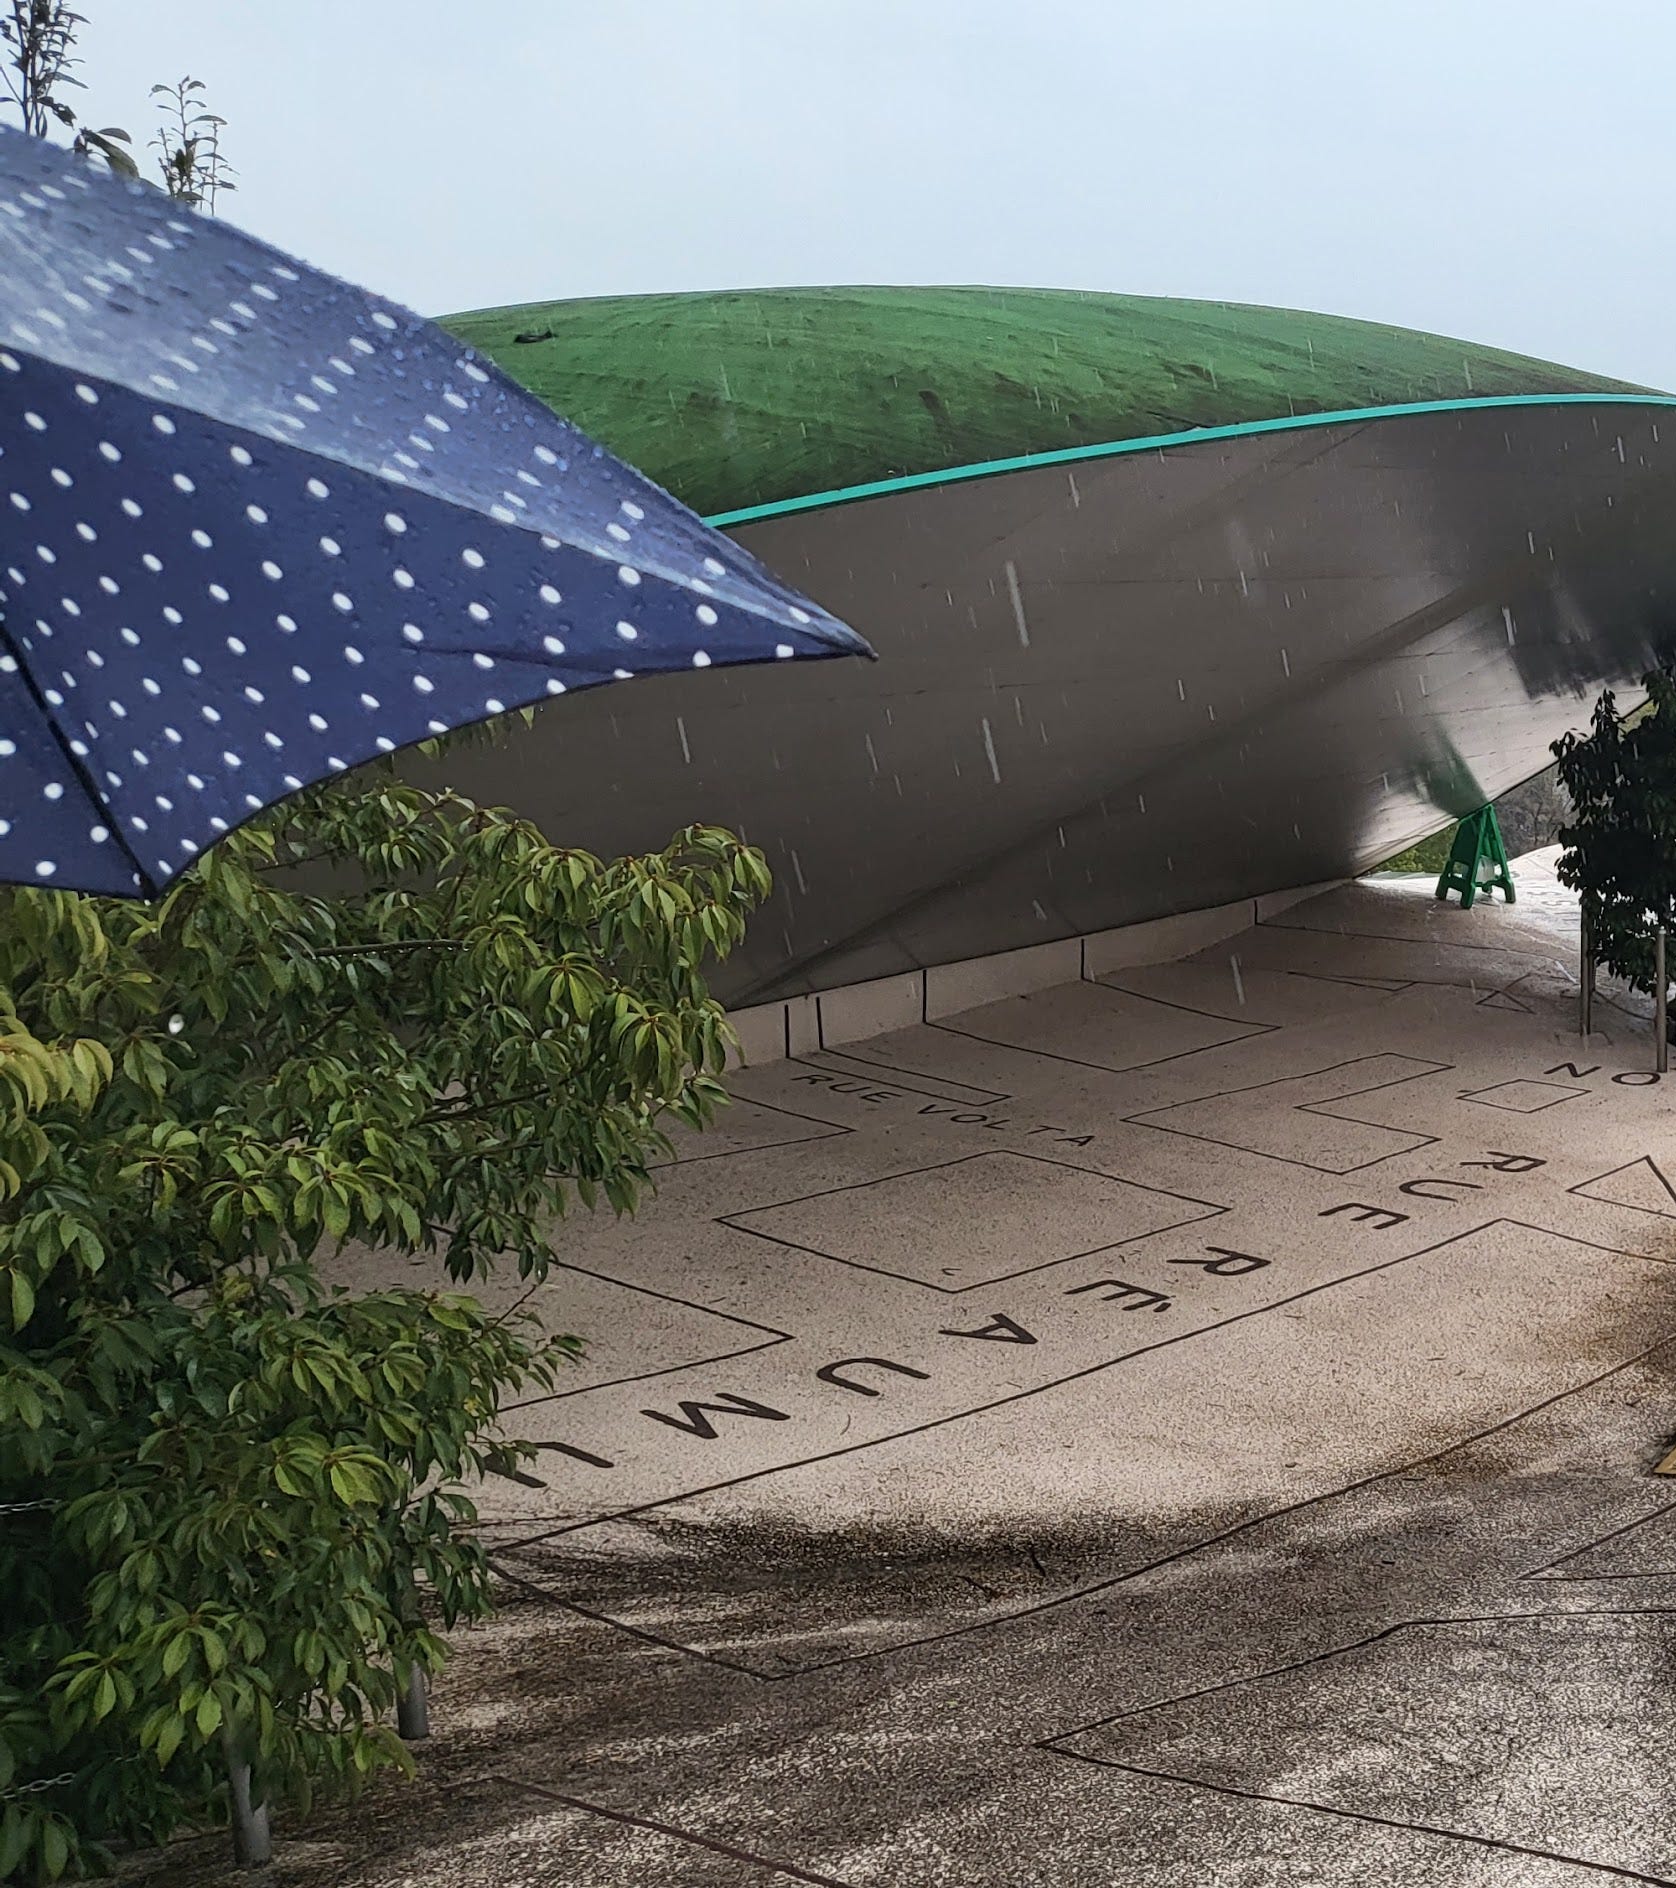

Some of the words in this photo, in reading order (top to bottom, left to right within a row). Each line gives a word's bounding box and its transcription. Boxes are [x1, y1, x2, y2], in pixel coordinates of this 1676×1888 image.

[790, 1073, 903, 1104] RUE
[917, 1103, 1097, 1148] VOLTA
[1317, 1150, 1548, 1230] RUE
